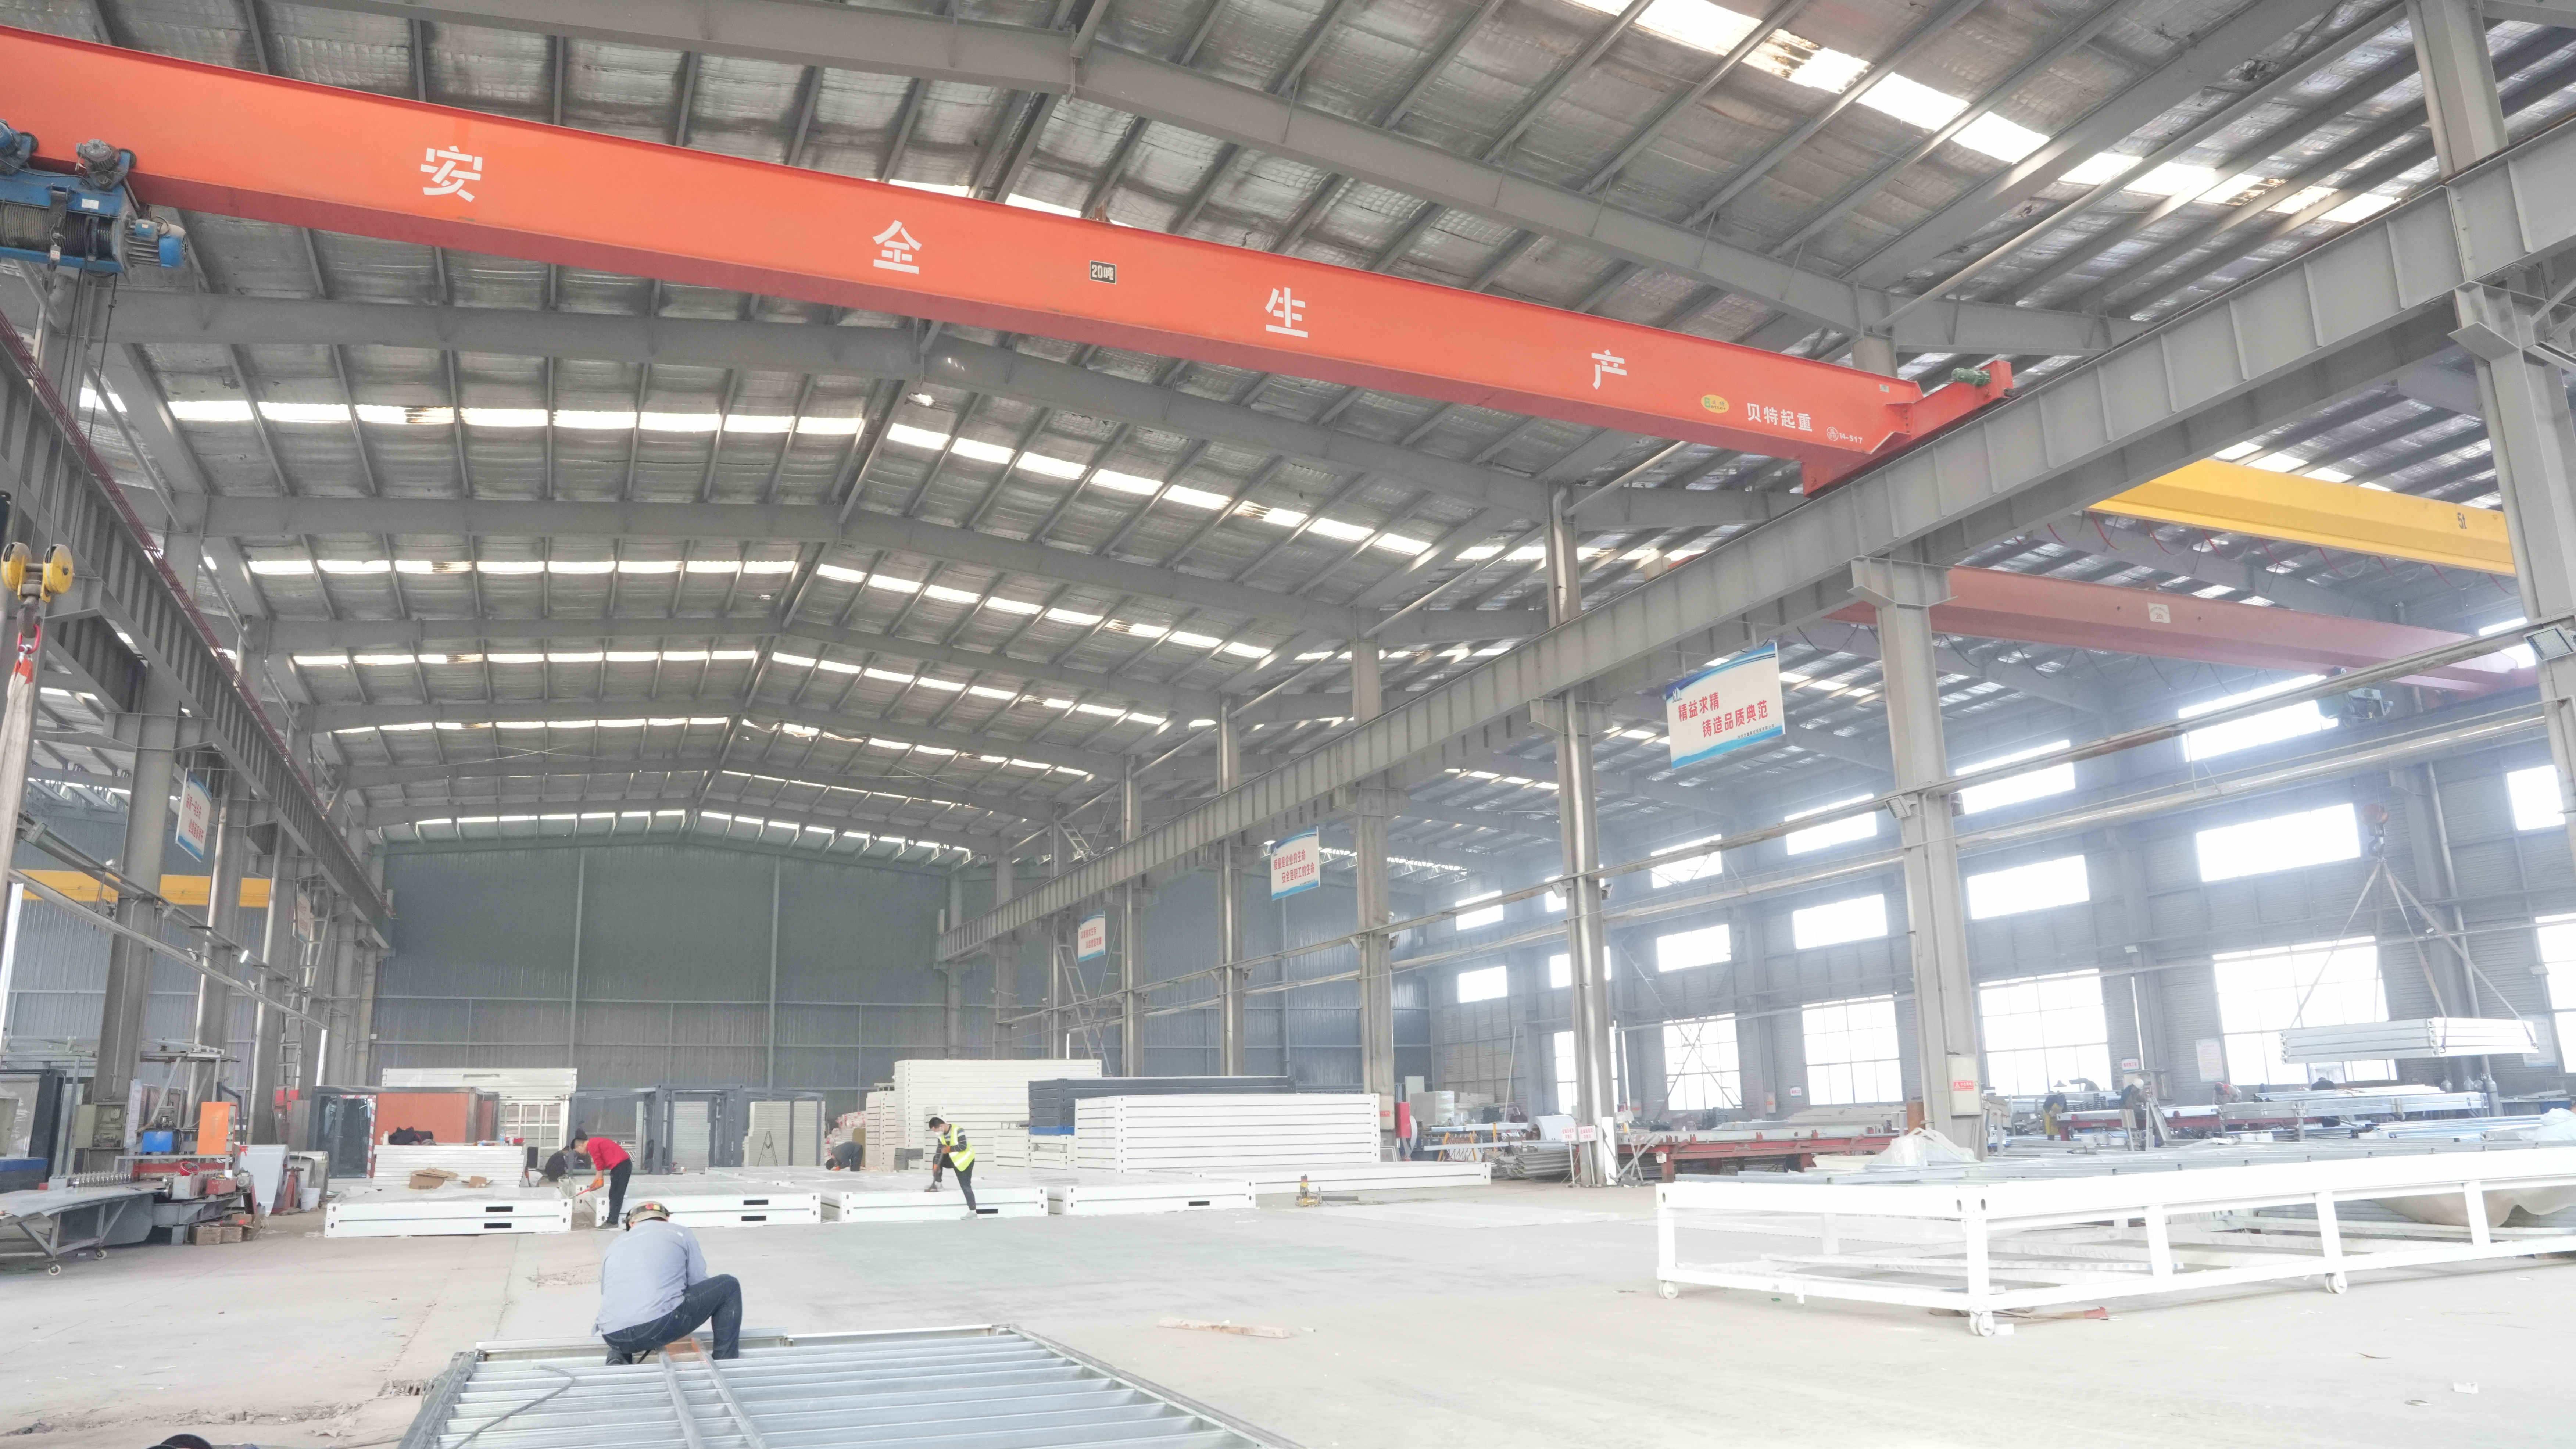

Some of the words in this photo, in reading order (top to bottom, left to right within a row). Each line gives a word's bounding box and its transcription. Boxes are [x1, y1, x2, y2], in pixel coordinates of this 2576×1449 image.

[420, 145, 483, 202] 安
[873, 220, 922, 275] 全
[1265, 287, 1308, 338] 生
[1591, 349, 1627, 390] 产
[1091, 264, 1114, 281] 20吨
[1747, 402, 1813, 432] 贝特起重
[1839, 433, 1863, 444] 14-517
[2457, 512, 2468, 529] 5t
[1678, 691, 1719, 722] 精益求精
[1702, 700, 1768, 738] 铸造品质典范
[1274, 849, 1306, 871] 质量是企业的生命
[1282, 862, 1314, 884] 安全是职工的生命
